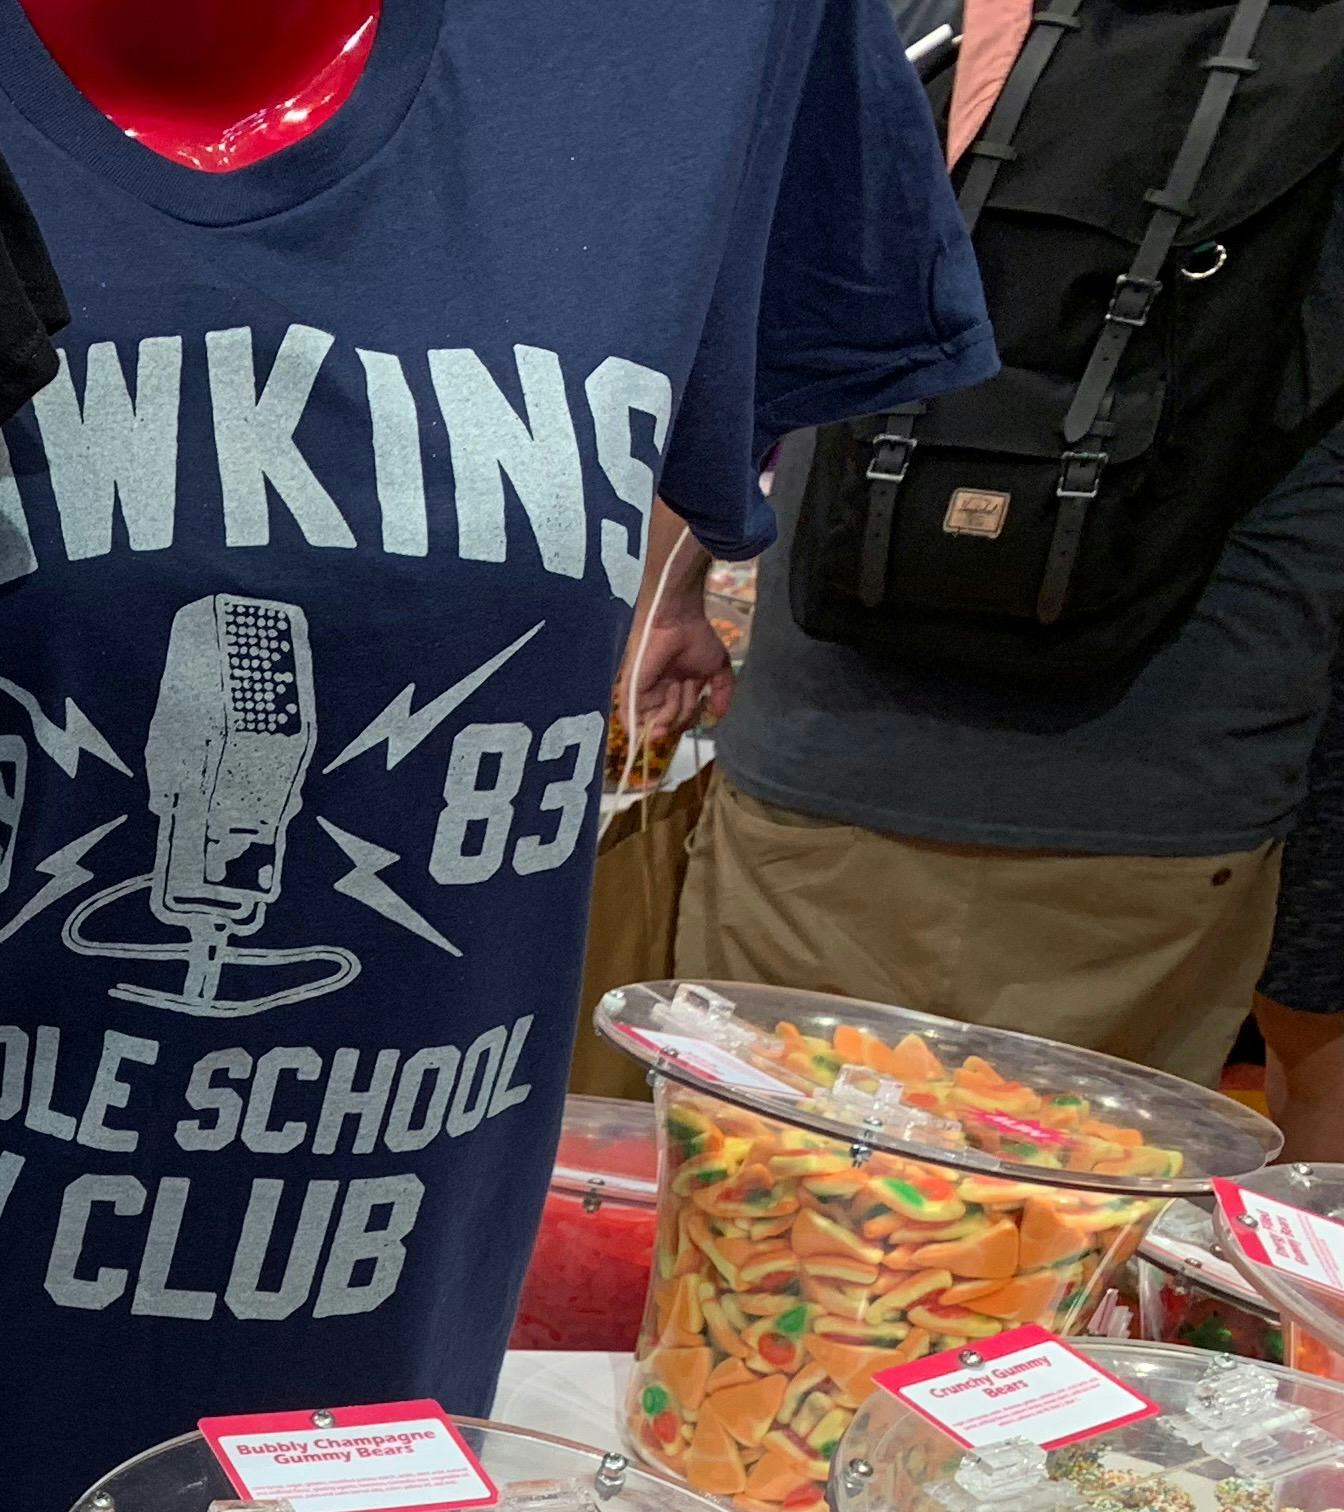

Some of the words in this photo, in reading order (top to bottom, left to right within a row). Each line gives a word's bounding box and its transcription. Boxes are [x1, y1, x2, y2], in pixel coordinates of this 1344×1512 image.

[430, 709, 605, 885] 83
[173, 1015, 535, 1155] SCHOOL
[43, 1172, 426, 1321] CLUB
[929, 1372, 992, 1400] Crunchy
[991, 1354, 1054, 1387] Gummy
[983, 1377, 1030, 1399] Bears
[235, 1438, 309, 1457] Bubbly
[313, 1428, 437, 1452] Champagne
[273, 1445, 352, 1466] Gummy
[357, 1443, 416, 1458] Bears
